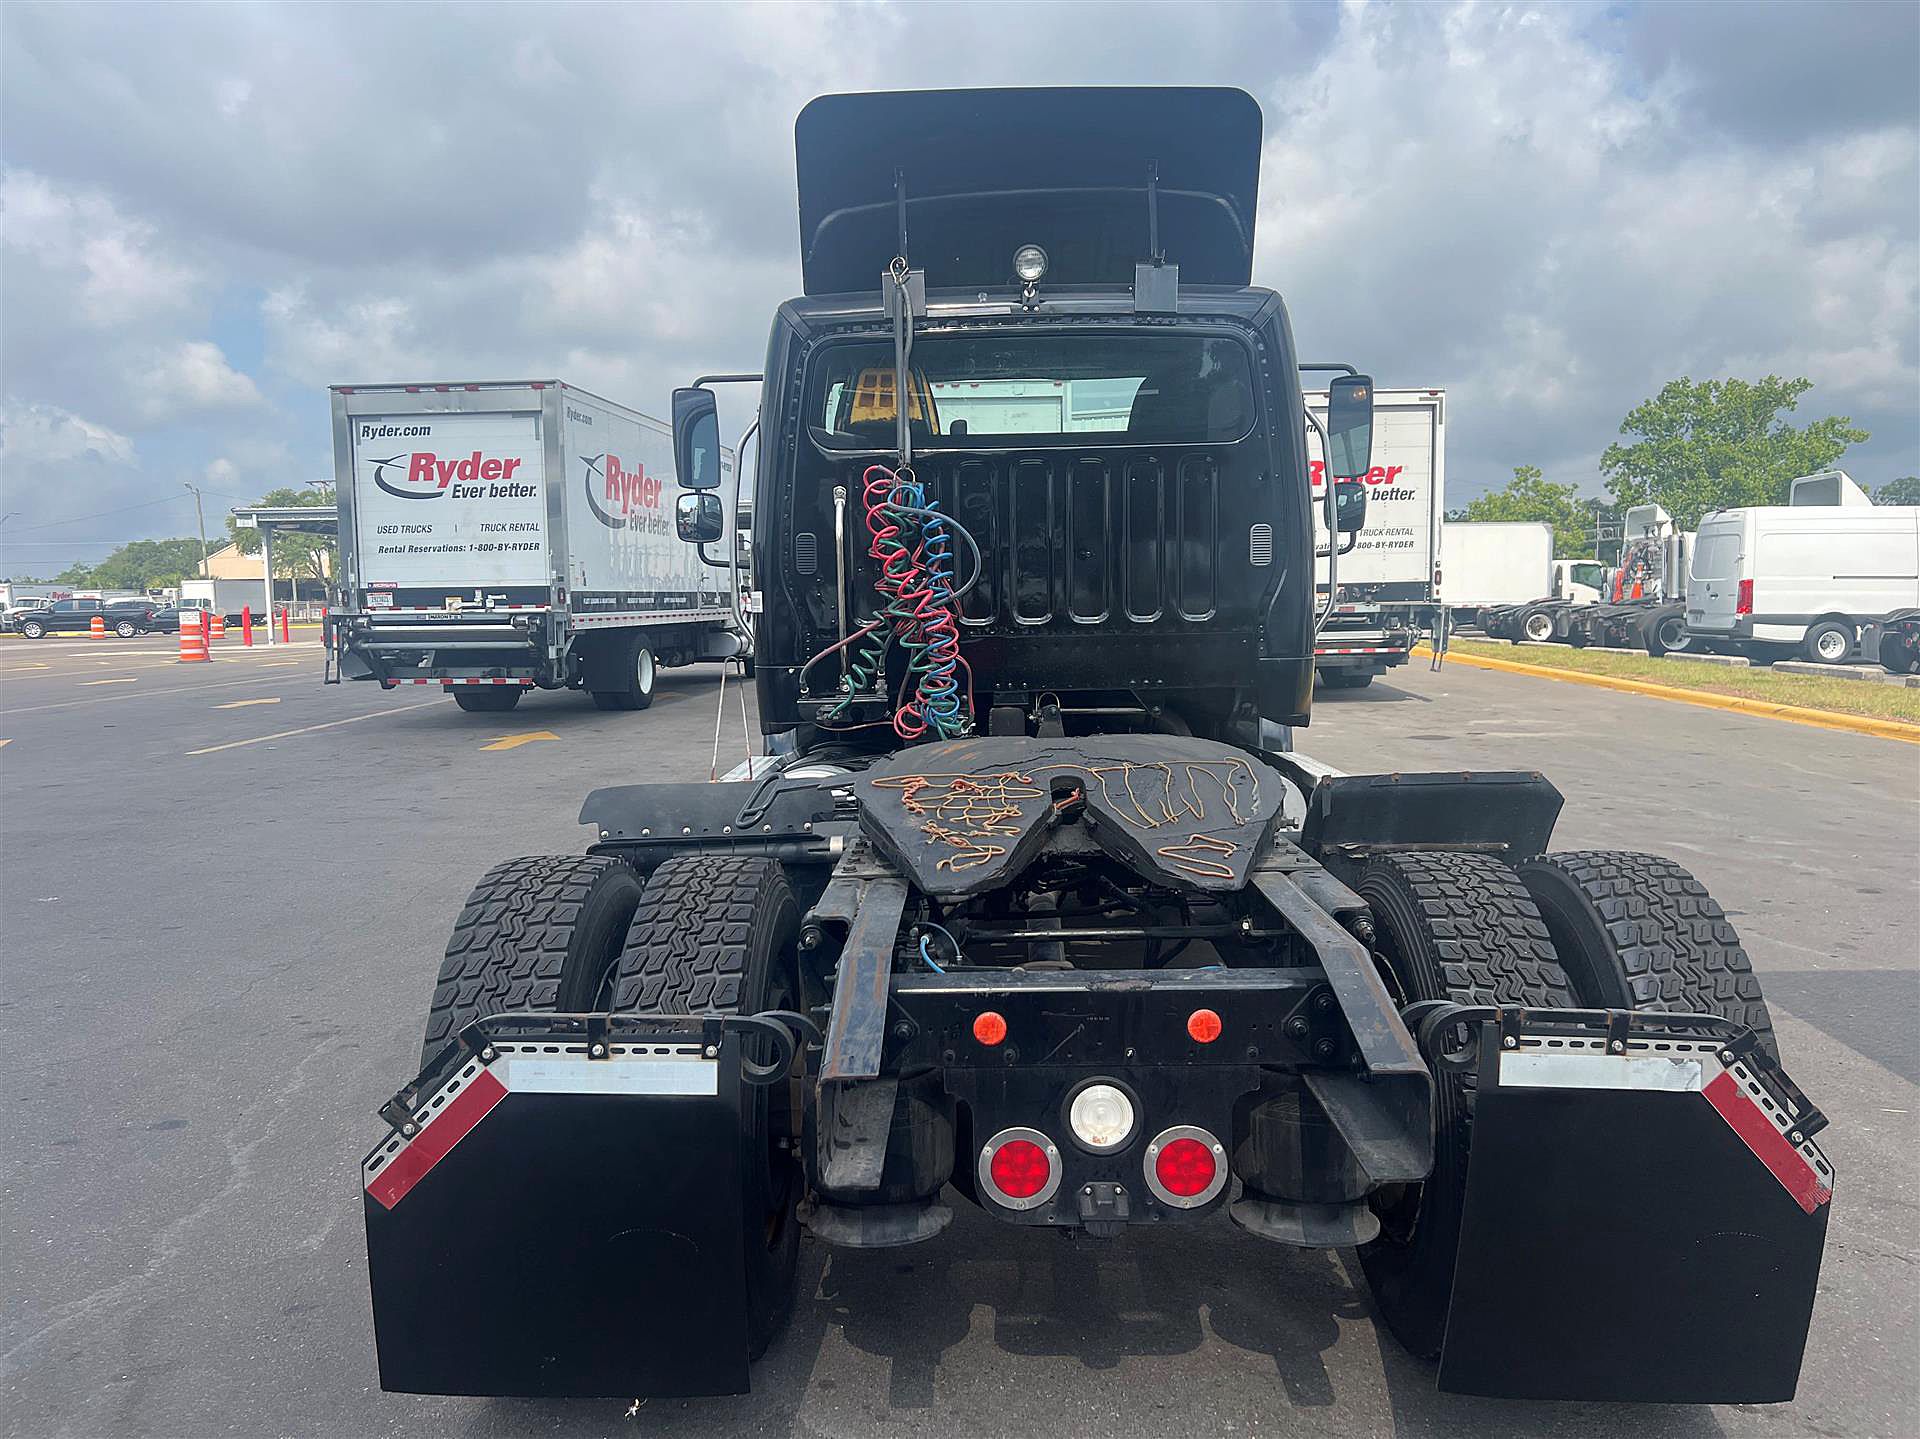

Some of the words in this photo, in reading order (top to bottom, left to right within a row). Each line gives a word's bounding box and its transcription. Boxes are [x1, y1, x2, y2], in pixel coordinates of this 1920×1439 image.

[566, 406, 593, 426] Ryder.com
[361, 425, 431, 440] Ryder.com
[408, 451, 521, 489] Ryder
[451, 484, 486, 499] Ever
[488, 482, 537, 498] better.
[605, 454, 662, 514] Ryder
[1371, 487, 1416, 501] better.
[480, 523, 507, 532] TRUCK
[508, 522, 540, 532] RENTAL
[629, 509, 646, 532] Ever
[377, 525, 398, 535] USED
[401, 524, 433, 534] TRUCKS
[1385, 528, 1414, 536] RENTAL
[378, 545, 406, 554] Rental
[407, 544, 466, 553] Reservations:
[469, 542, 540, 552] 1-800-BY-RYDER
